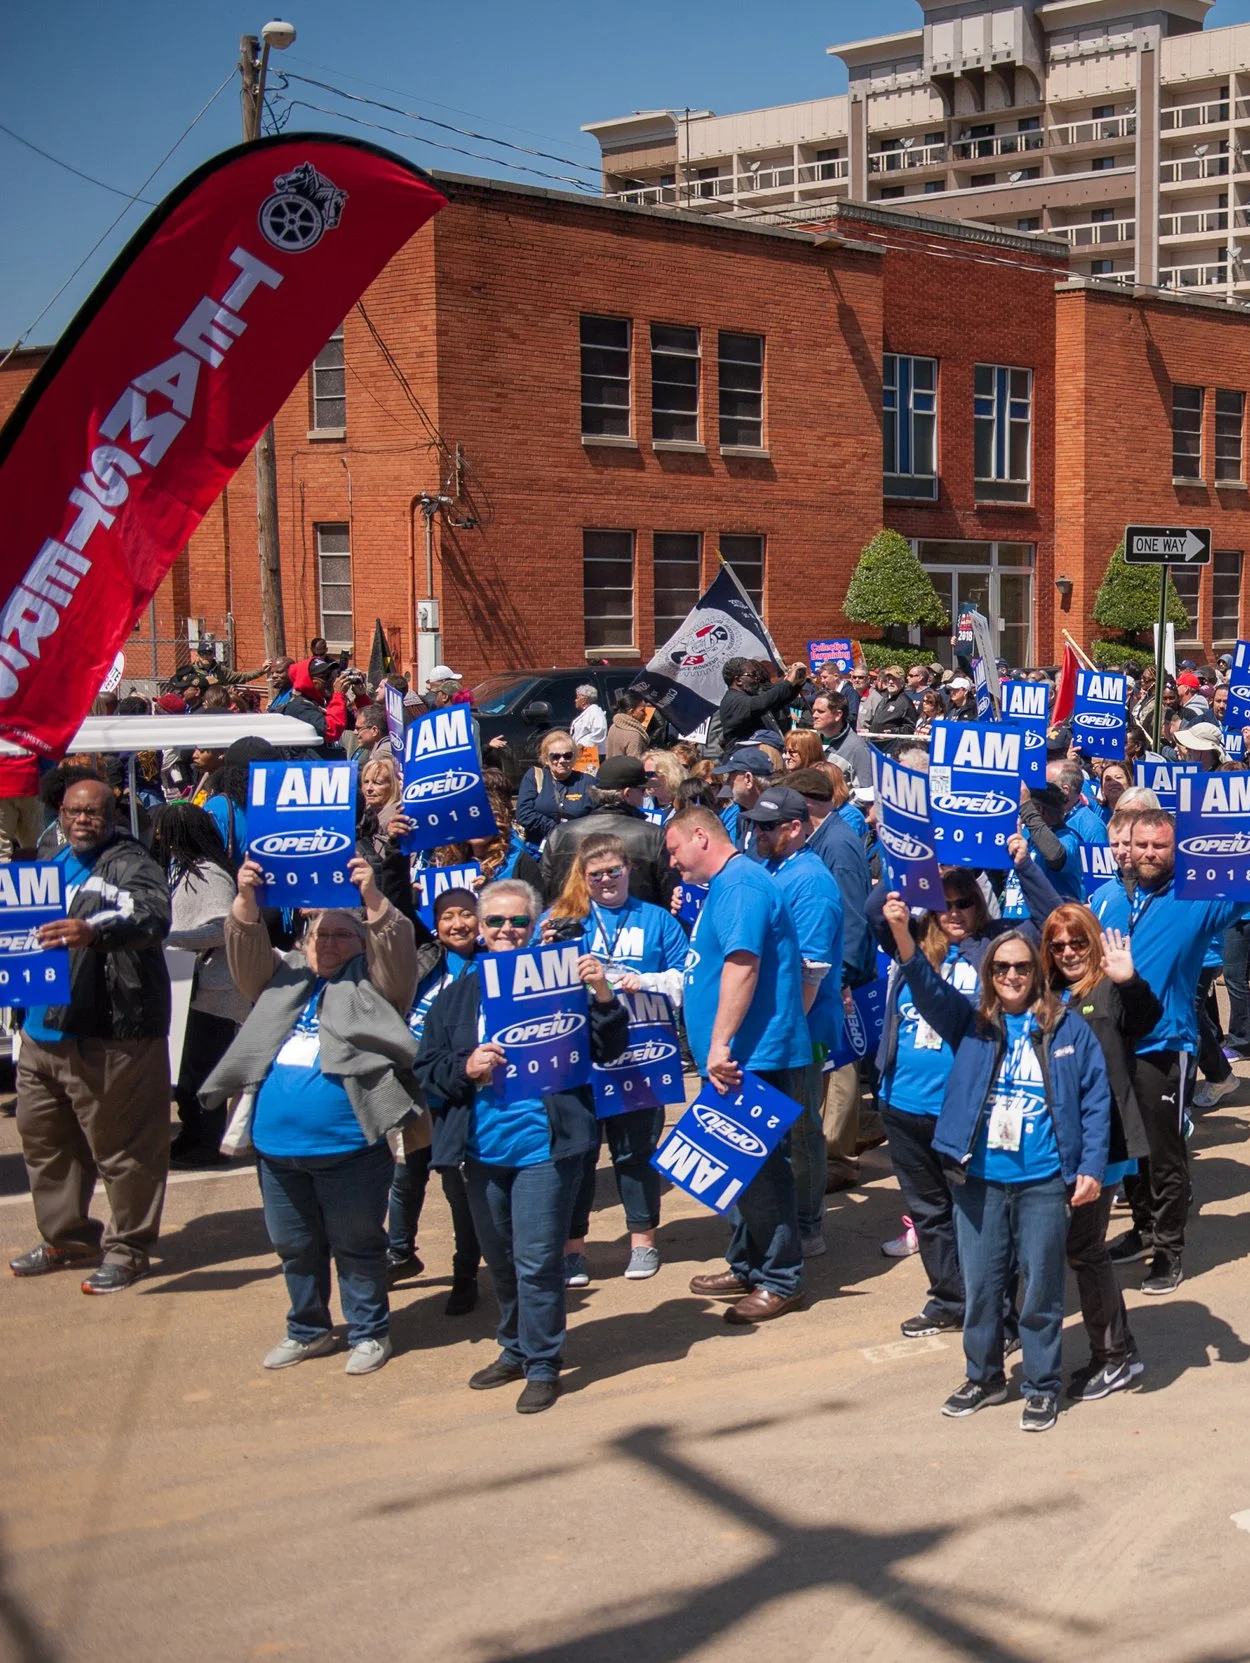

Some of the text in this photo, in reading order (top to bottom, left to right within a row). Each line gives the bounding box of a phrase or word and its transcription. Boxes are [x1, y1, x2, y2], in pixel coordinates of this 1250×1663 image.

[1136, 538, 1186, 552] ONE WAY
[811, 643, 848, 651] Collective
[958, 631, 973, 641] 2018
[1235, 644, 1245, 667] I
[1077, 673, 1123, 700] I AM
[1002, 685, 1046, 714] I AM
[1080, 715, 1116, 727] OPEIU
[405, 709, 469, 763] I AM
[933, 727, 1021, 770] I AM
[1077, 735, 1118, 746] 2018
[252, 767, 350, 806] I AM
[407, 773, 467, 798] OPEIU
[871, 751, 928, 816] I AM
[1137, 765, 1144, 788] I
[939, 797, 1005, 813] OPEIU
[1180, 778, 1191, 811] I
[410, 805, 481, 830] 2018
[263, 834, 338, 852] OPEIU
[879, 829, 921, 857] OPEIU
[934, 827, 1005, 846] 2018
[1080, 846, 1088, 872] I
[265, 871, 344, 885] 2018
[888, 866, 930, 889] 018
[420, 875, 428, 906] I
[677, 886, 700, 909] 201
[0, 934, 43, 950] PEI
[0, 969, 56, 981] 018
[483, 946, 580, 998] I AM
[504, 1016, 574, 1043] OPEIU
[505, 1051, 580, 1078] 2018
[604, 1074, 672, 1096] 2018
[735, 1095, 777, 1128] 201
[700, 1111, 758, 1154] OPEIU
[656, 1139, 743, 1210] I AM
